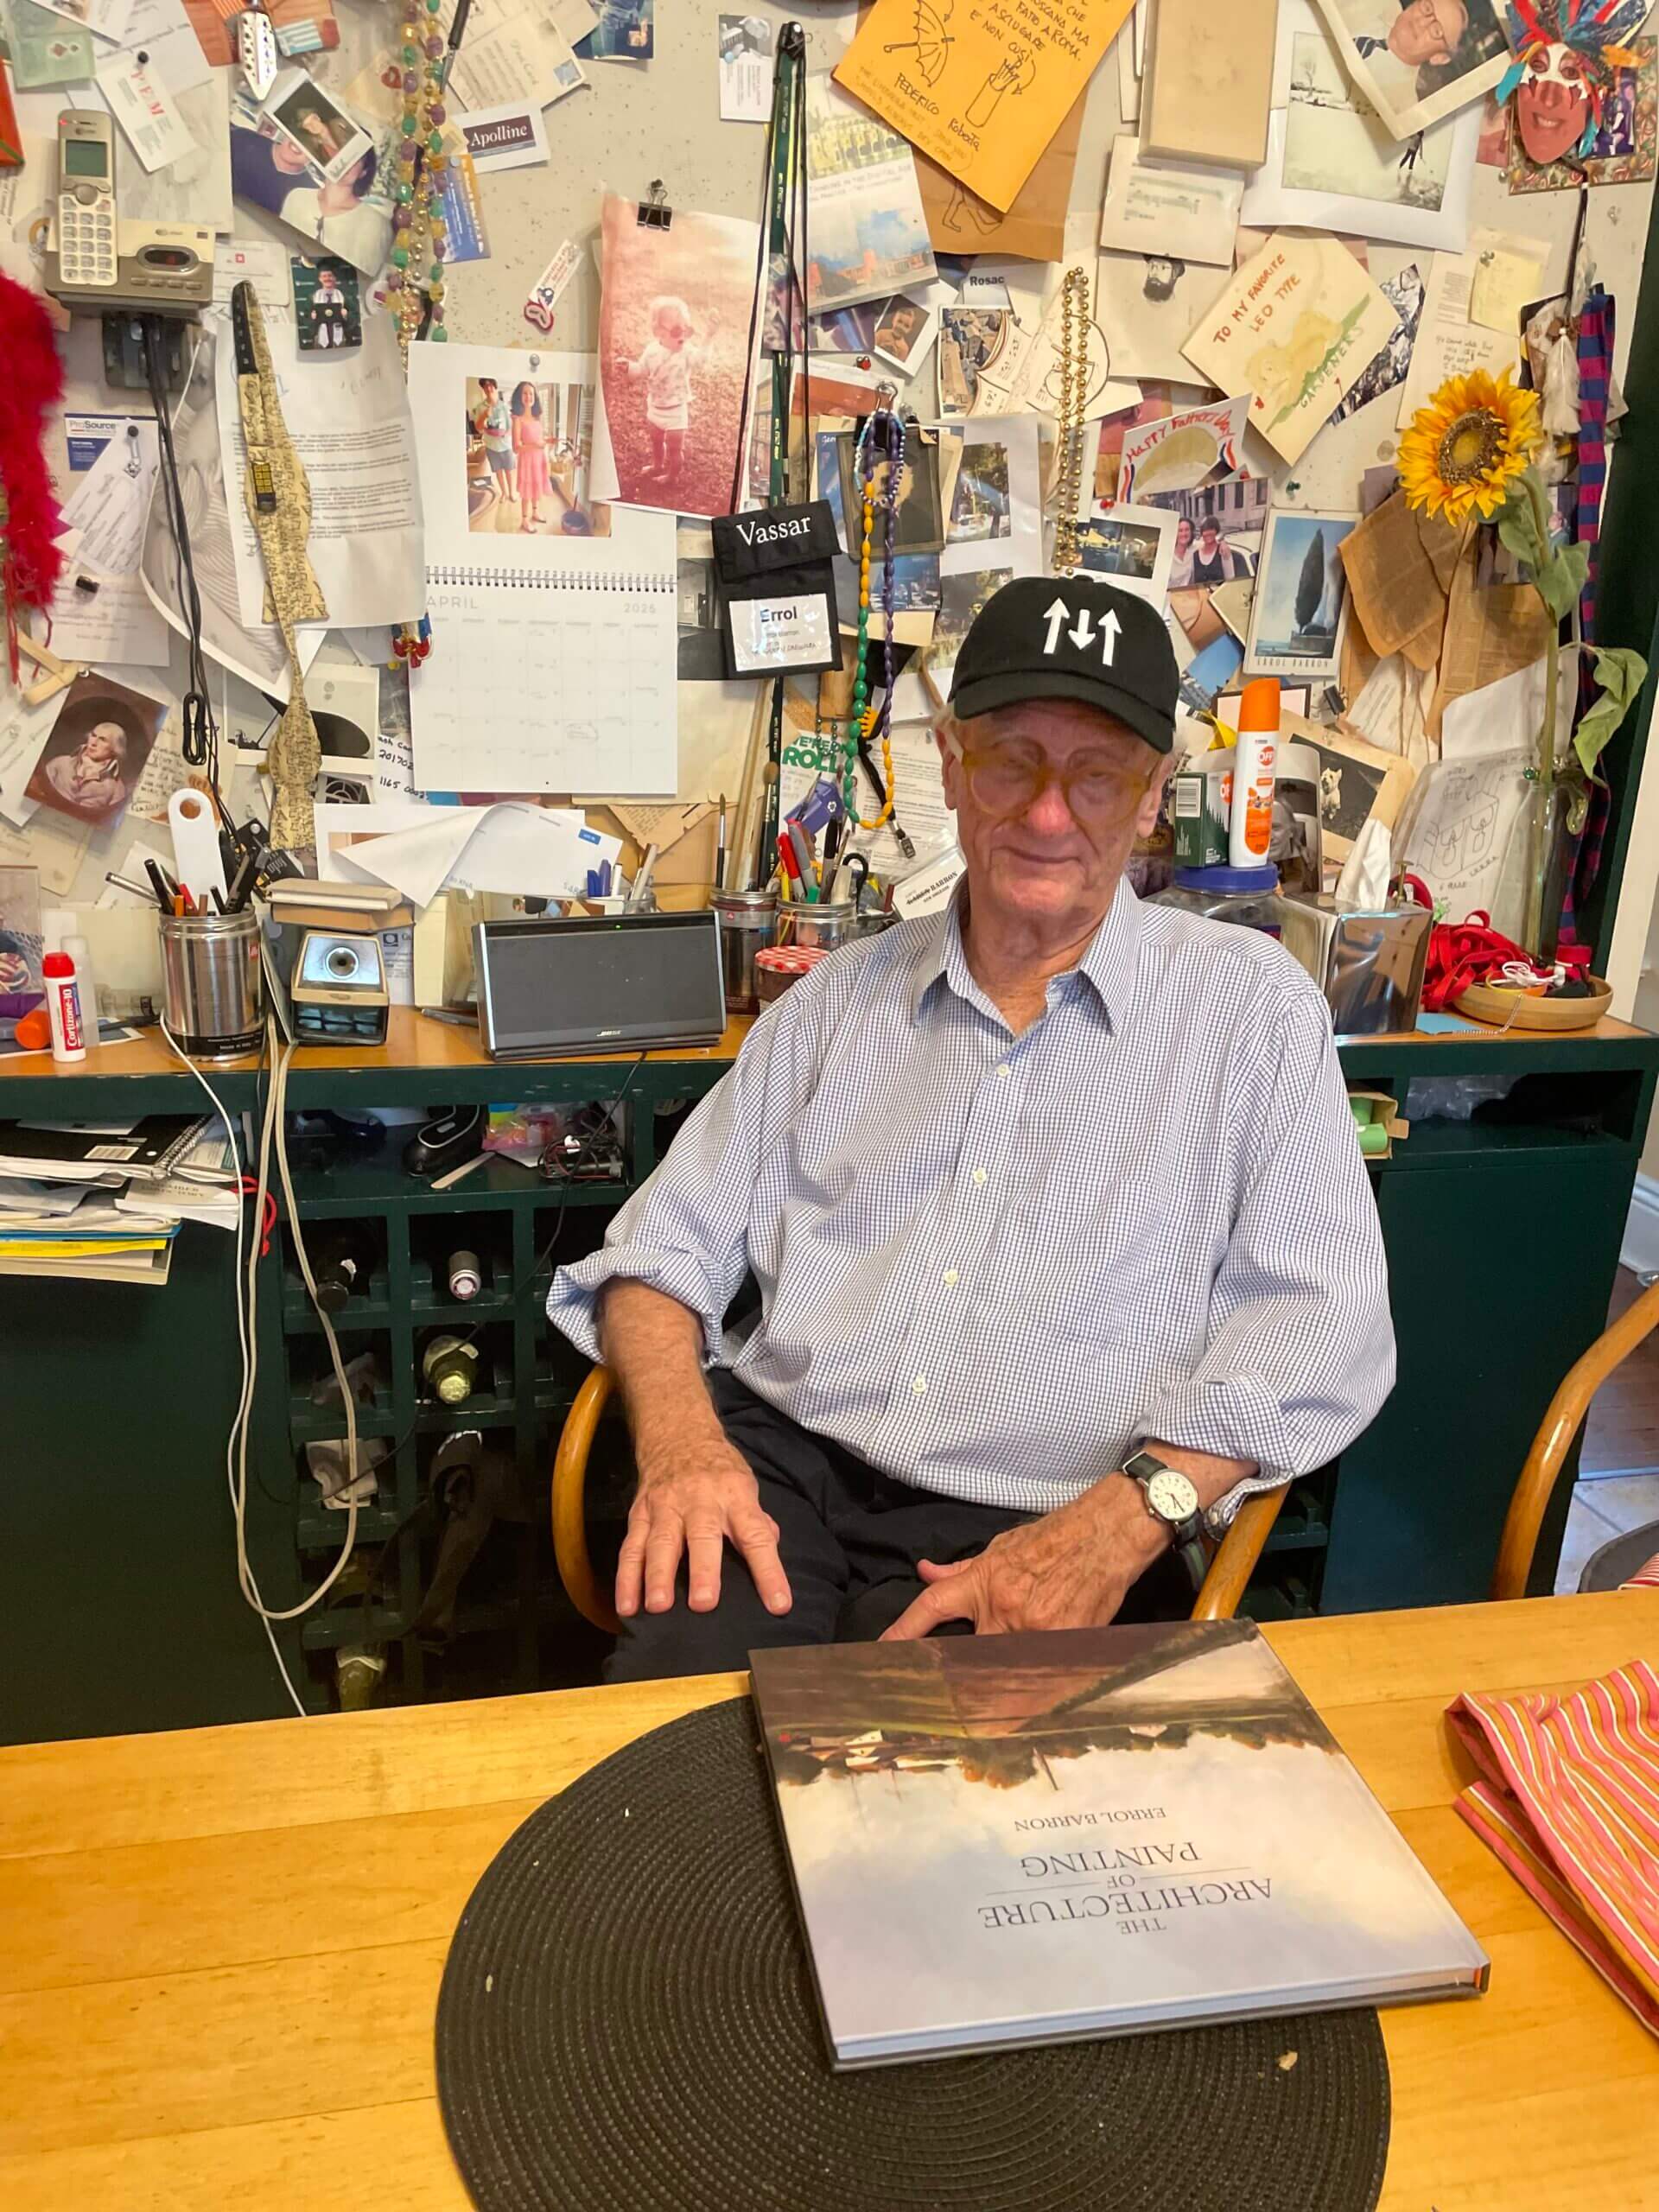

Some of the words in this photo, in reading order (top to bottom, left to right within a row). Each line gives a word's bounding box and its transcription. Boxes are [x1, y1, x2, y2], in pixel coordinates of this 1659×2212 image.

[982, 20, 1004, 41] NON
[1071, 27, 1090, 47] MA
[471, 124, 528, 147] Apolline
[969, 275, 1005, 286] Rosac
[1212, 325, 1231, 345] TO
[1231, 300, 1249, 322] MY
[1248, 253, 1286, 302] FAVORITE
[1250, 303, 1273, 334] LEO
[1275, 273, 1301, 302] TYPE
[736, 516, 811, 547] Vassar
[427, 595, 479, 610] APRIL
[624, 603, 657, 614] 2025
[760, 606, 798, 623] Errol
[782, 746, 840, 773] ROLL
[1257, 751, 1274, 763] OFF
[379, 776, 401, 790] 1165
[930, 871, 958, 891] BARRON
[61, 988, 78, 1047] Cortizone-10
[1014, 1814, 1098, 1832] BARRON
[1100, 1807, 1166, 1824] ERROL
[1020, 1841, 1202, 1878] PAINTING
[1107, 1873, 1136, 1889] OF
[977, 1878, 1273, 1929] ARCHITECTURE
[1116, 1916, 1168, 1936] THE
